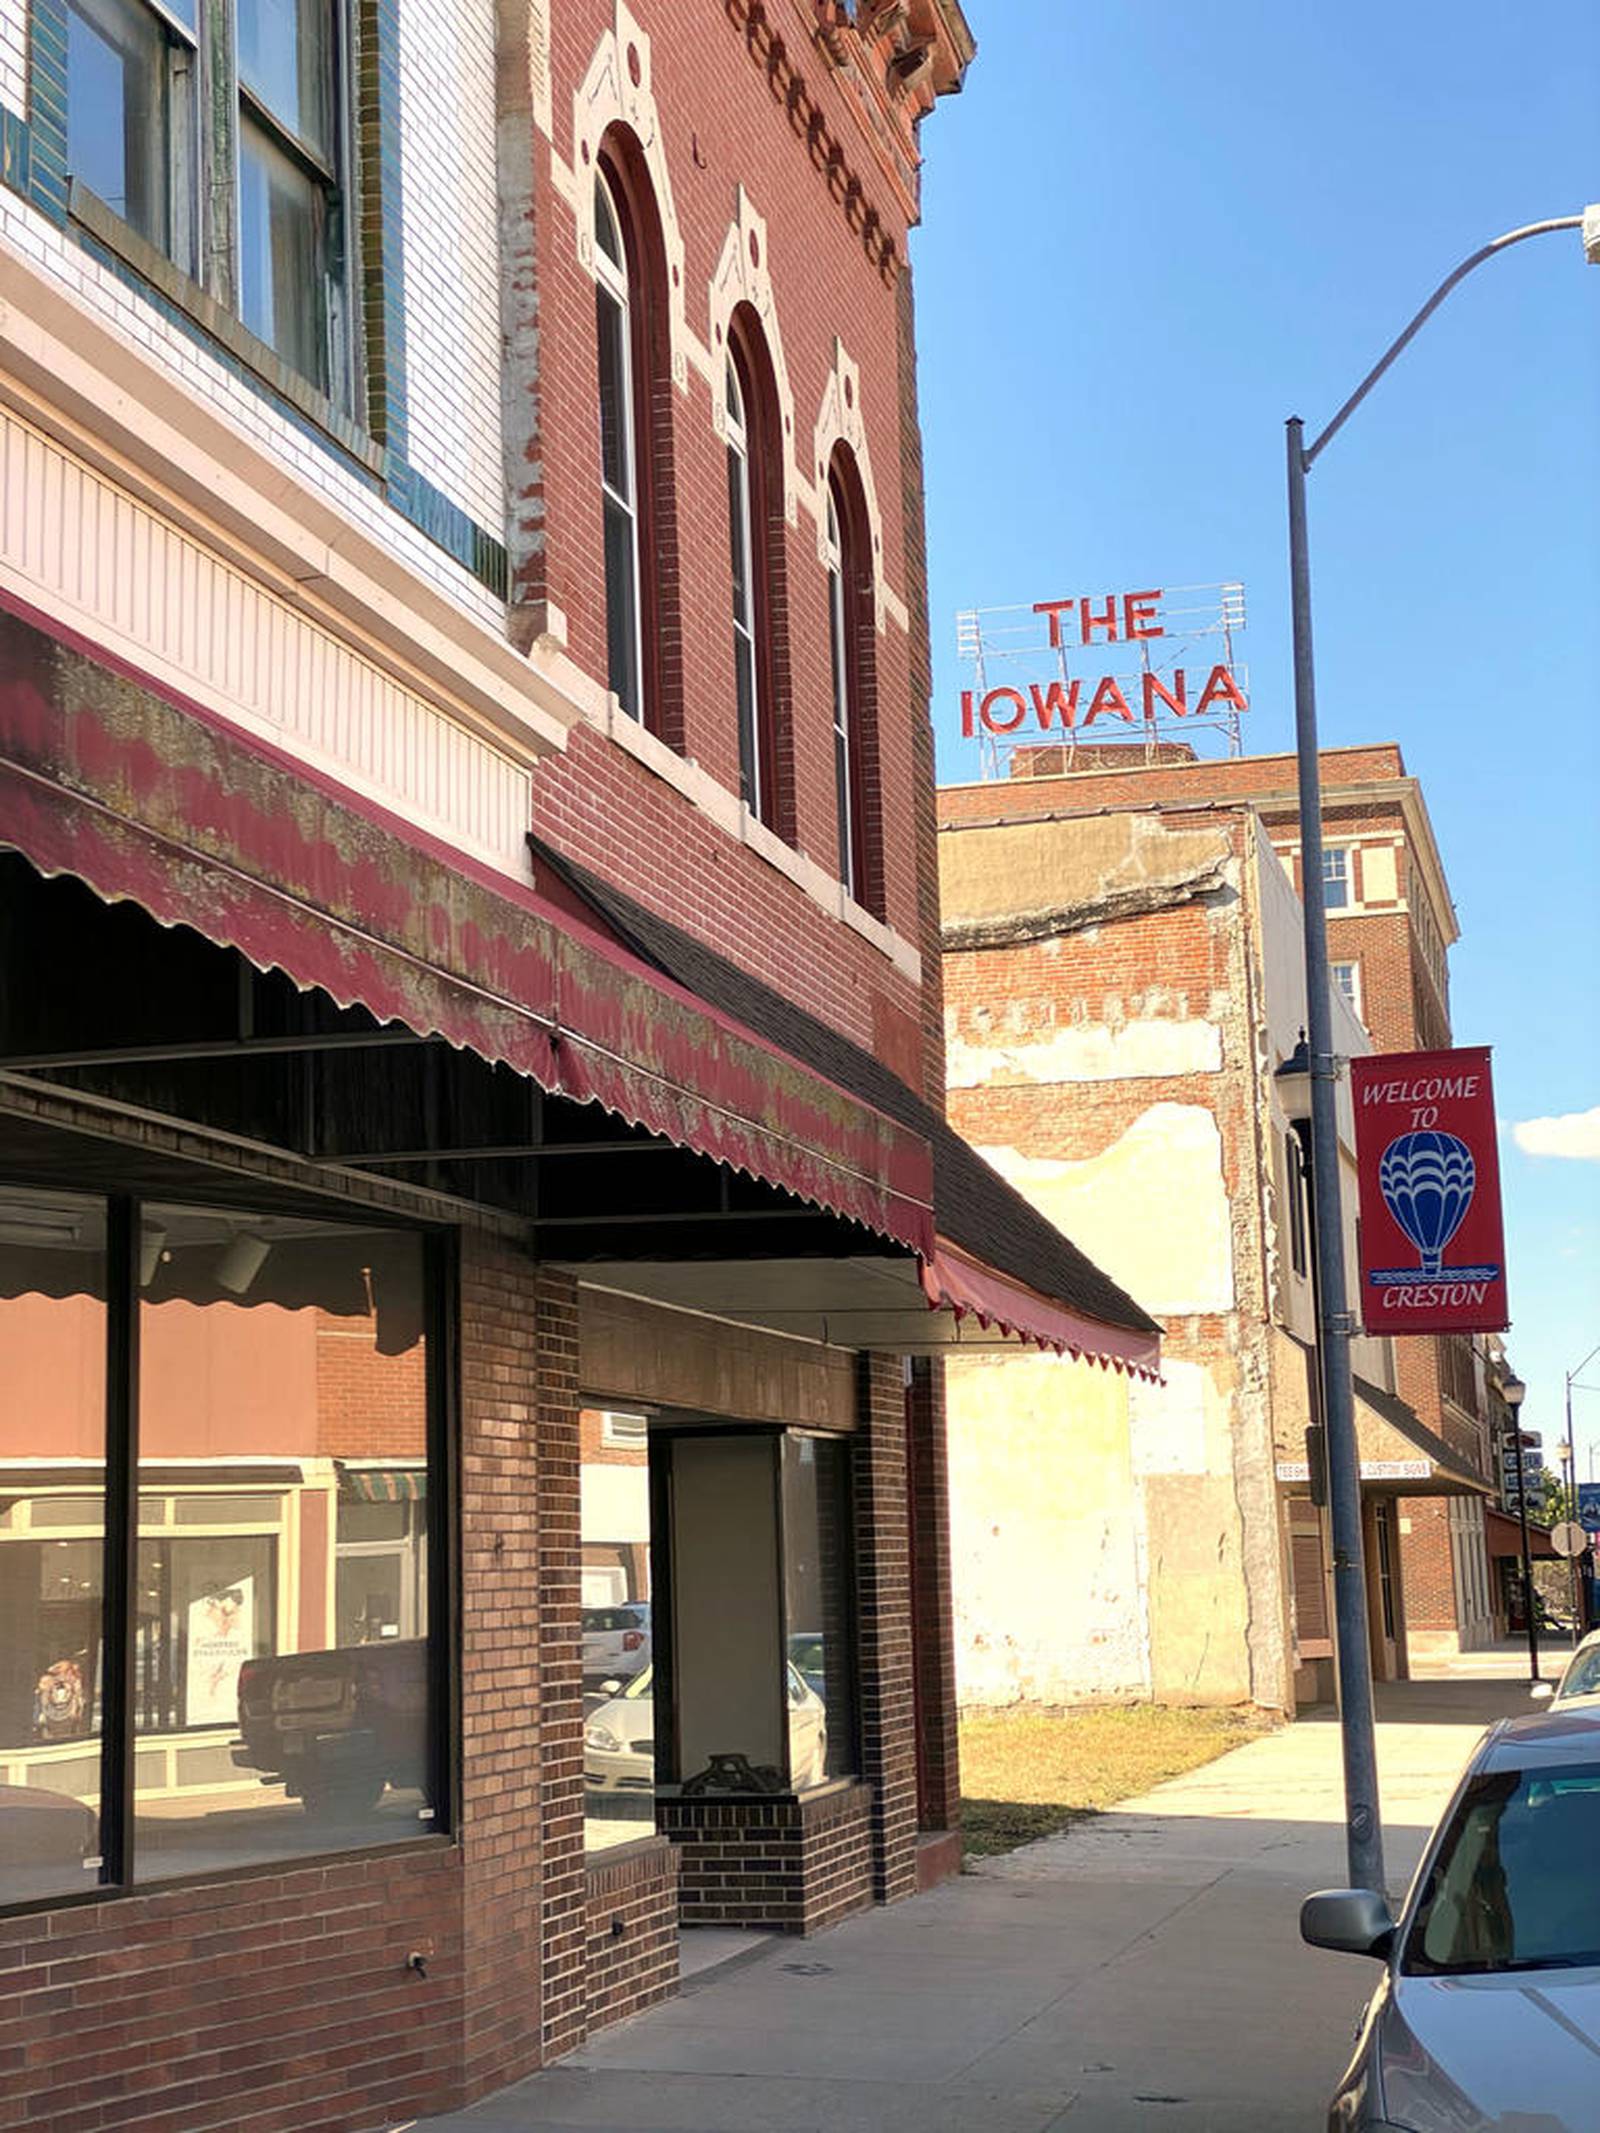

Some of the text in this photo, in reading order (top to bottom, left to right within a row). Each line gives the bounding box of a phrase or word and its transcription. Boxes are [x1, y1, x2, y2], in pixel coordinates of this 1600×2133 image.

[1033, 589, 1164, 648] THE
[960, 665, 1249, 738] IOWANA
[1363, 1076, 1480, 1105] WELCOME
[1410, 1106, 1439, 1129] TO
[1382, 1284, 1488, 1309] CRESTON
